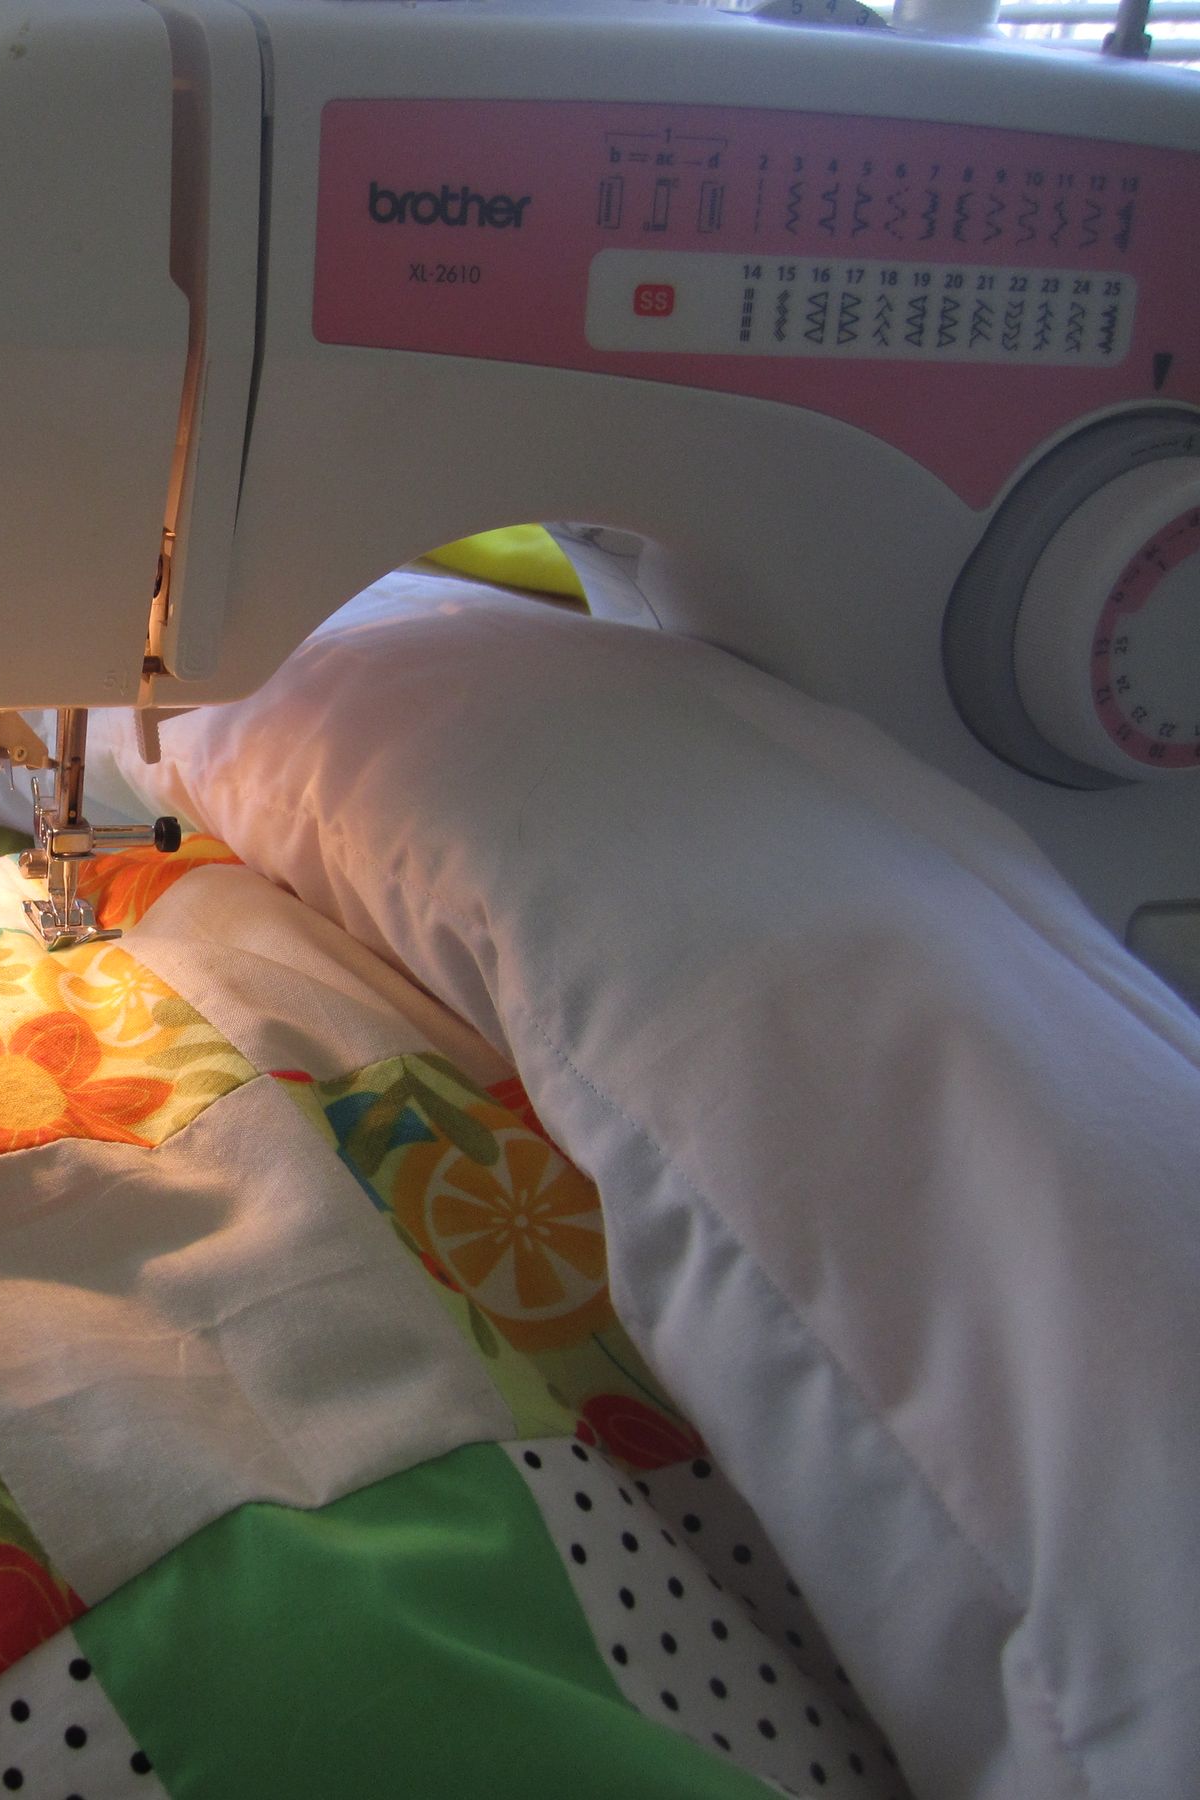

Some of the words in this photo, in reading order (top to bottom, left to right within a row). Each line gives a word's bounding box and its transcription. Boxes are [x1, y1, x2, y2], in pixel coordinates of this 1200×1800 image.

[609, 146, 622, 163] b
[708, 151, 721, 169] d
[758, 153, 769, 171] 2
[793, 155, 804, 172] 3
[827, 157, 839, 174] 4
[862, 160, 873, 176] 5
[896, 162, 907, 179] 6
[929, 164, 941, 182] 7
[996, 168, 1007, 184] 9
[1026, 170, 1045, 187] 10
[1058, 173, 1075, 188] 11
[368, 181, 532, 229] brother
[409, 263, 481, 284] XL-2610
[743, 264, 762, 280] 14
[777, 265, 796, 282] 15
[812, 266, 831, 283] 16
[845, 268, 864, 285] 17
[881, 269, 899, 286] 18
[913, 271, 931, 288] 19
[945, 273, 964, 289] 20
[977, 274, 995, 290] 21
[1009, 276, 1029, 292] 22
[1041, 278, 1060, 294] 23
[1072, 279, 1091, 296] 24
[1103, 281, 1121, 297] 25
[639, 289, 668, 311] SS
[1114, 636, 1129, 655] 25
[1116, 675, 1131, 694] 24
